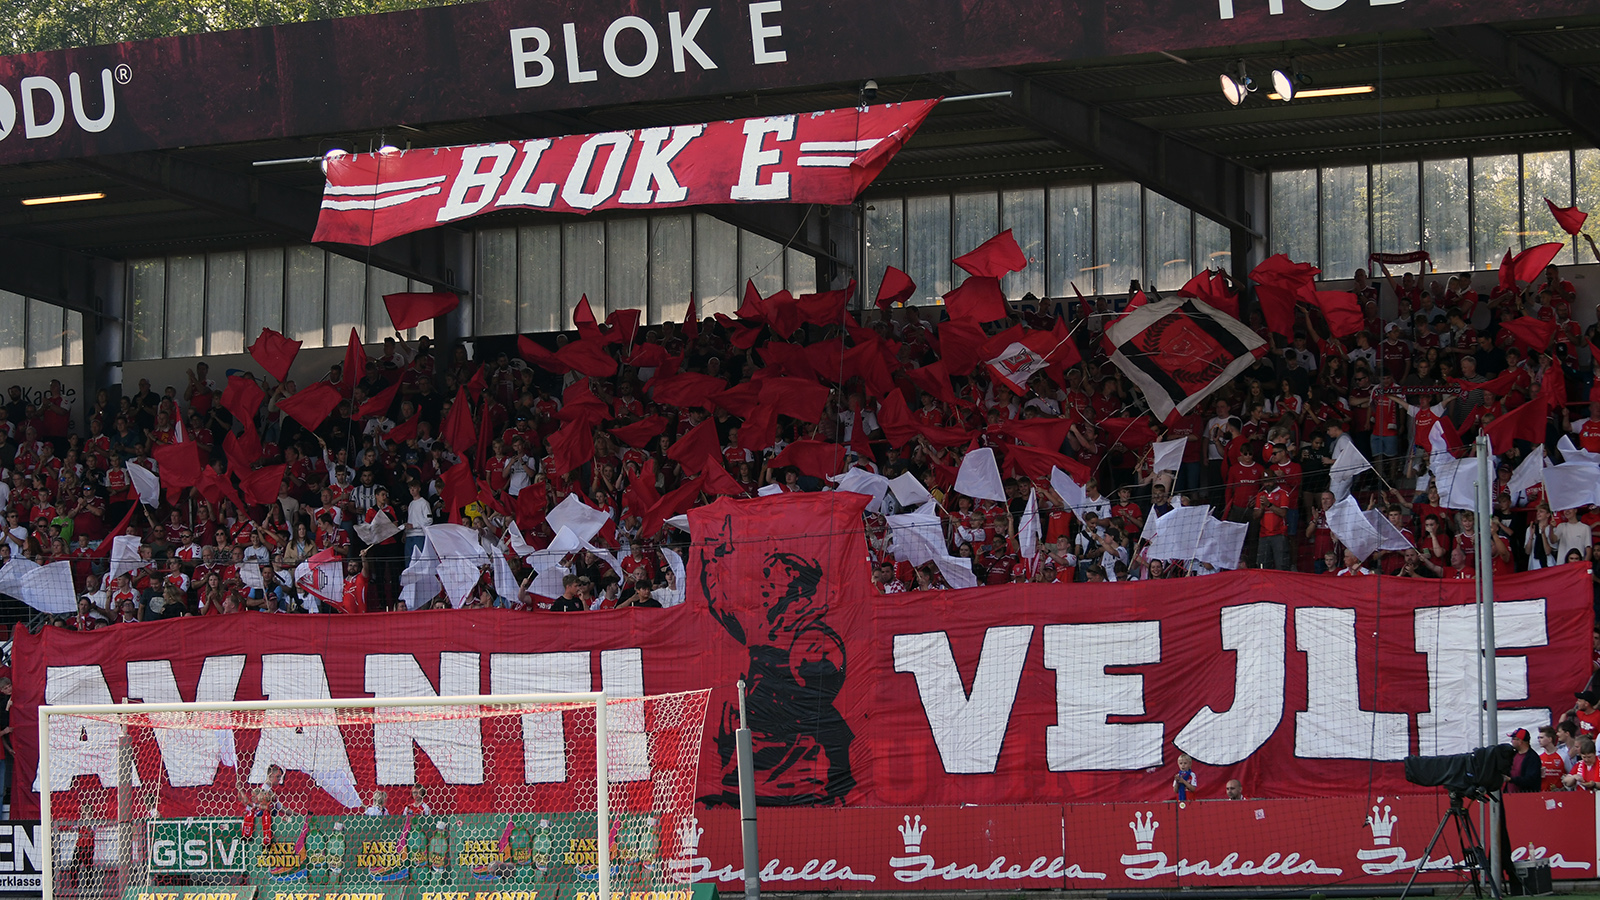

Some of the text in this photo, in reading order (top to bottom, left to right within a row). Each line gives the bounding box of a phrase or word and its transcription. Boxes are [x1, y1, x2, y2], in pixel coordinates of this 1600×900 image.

[509, 1, 789, 89] BLOK E
[436, 114, 799, 222] BLOK E
[31, 597, 1553, 793] AVANTI VEJLE
[152, 839, 239, 867] GSV
[263, 842, 296, 855] FAXE
[363, 841, 397, 854] FAXE
[464, 839, 500, 852] FAXE
[569, 838, 599, 851] FAX
[256, 854, 301, 867] KONDI
[356, 854, 402, 867] KONDI
[459, 853, 505, 866] KONDI
[563, 852, 599, 865] KON
[1119, 850, 1343, 879] Isabella
[1356, 846, 1592, 876] Isalla
[668, 857, 876, 883] Isbella
[889, 854, 1107, 883] Isabella
